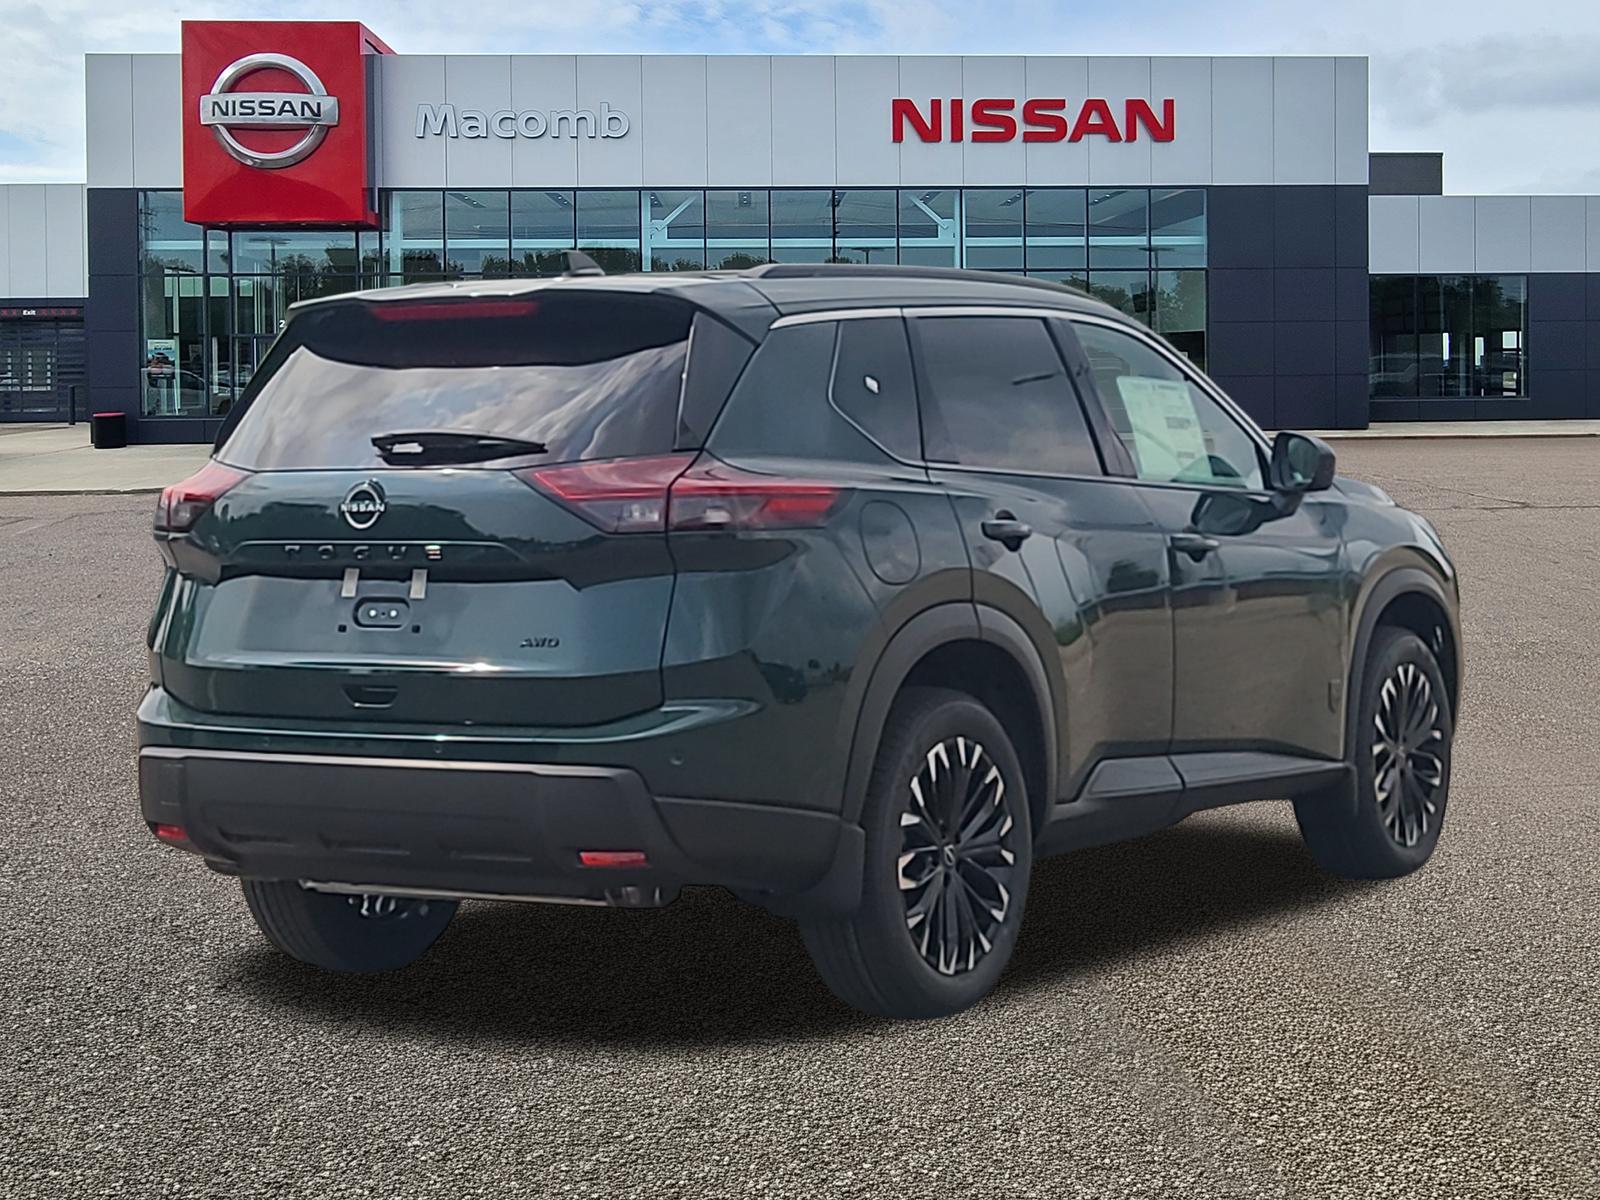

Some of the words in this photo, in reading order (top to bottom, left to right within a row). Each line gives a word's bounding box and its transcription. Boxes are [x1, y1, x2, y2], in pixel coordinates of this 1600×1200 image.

[212, 100, 321, 117] NISSAN
[415, 101, 630, 138] Macomb
[892, 99, 1175, 143] NISSAN
[341, 501, 385, 512] NISSAN
[519, 637, 560, 648] AWD
